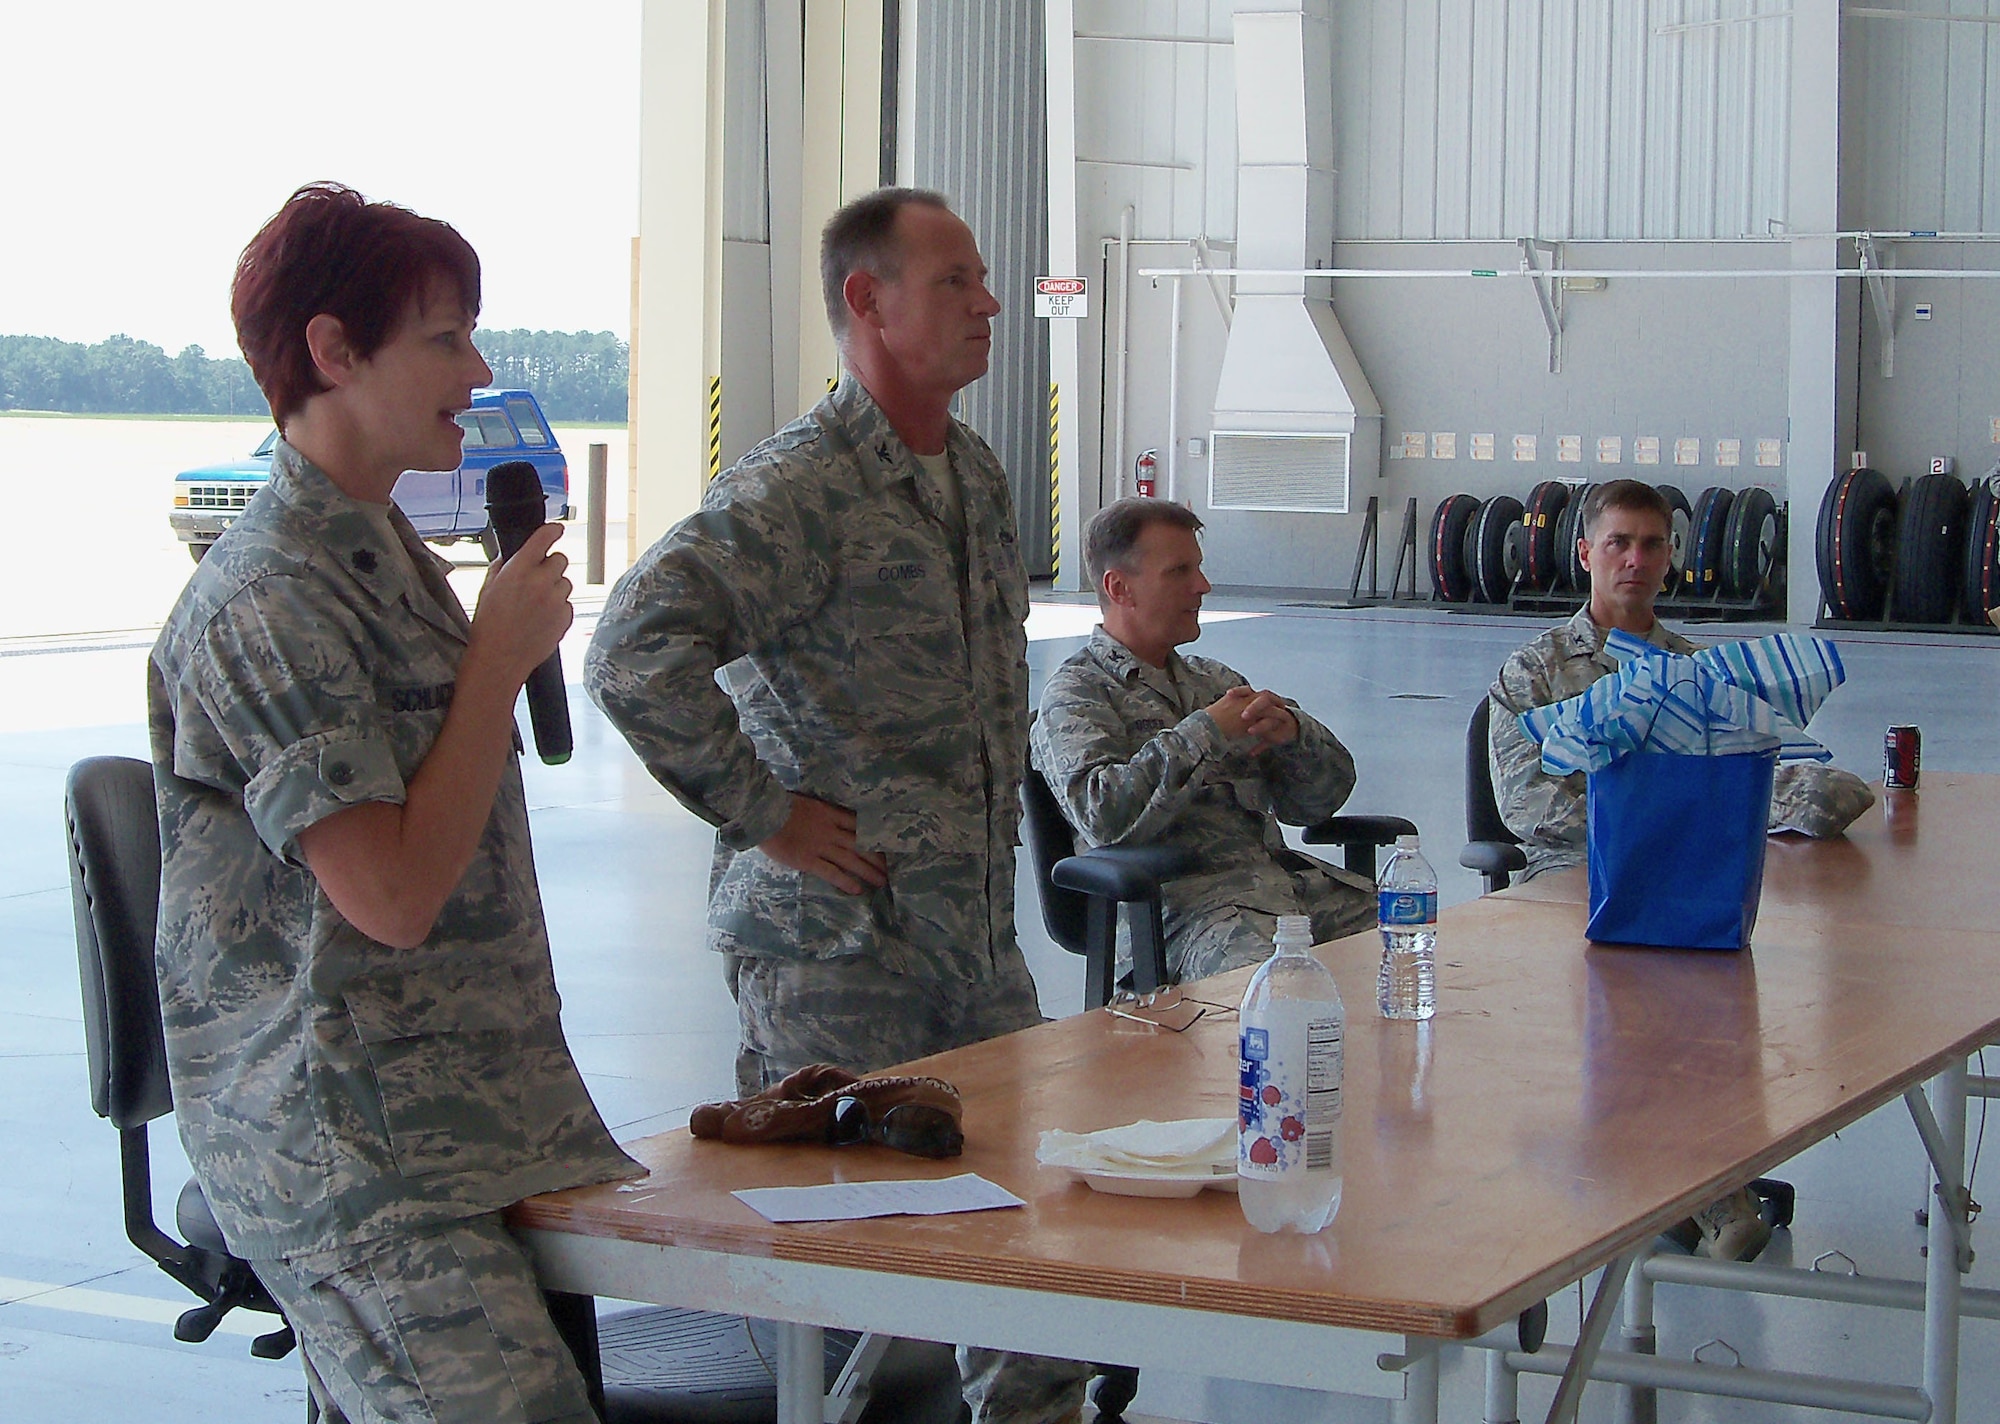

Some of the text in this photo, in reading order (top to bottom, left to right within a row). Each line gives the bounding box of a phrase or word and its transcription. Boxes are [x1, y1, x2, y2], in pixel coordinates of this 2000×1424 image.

[1044, 282, 1077, 291] DANGER
[1049, 296, 1073, 305] KEEP
[1052, 306, 1070, 315] OUT
[1933, 460, 1942, 472] 2
[878, 566, 926, 582] COMBS
